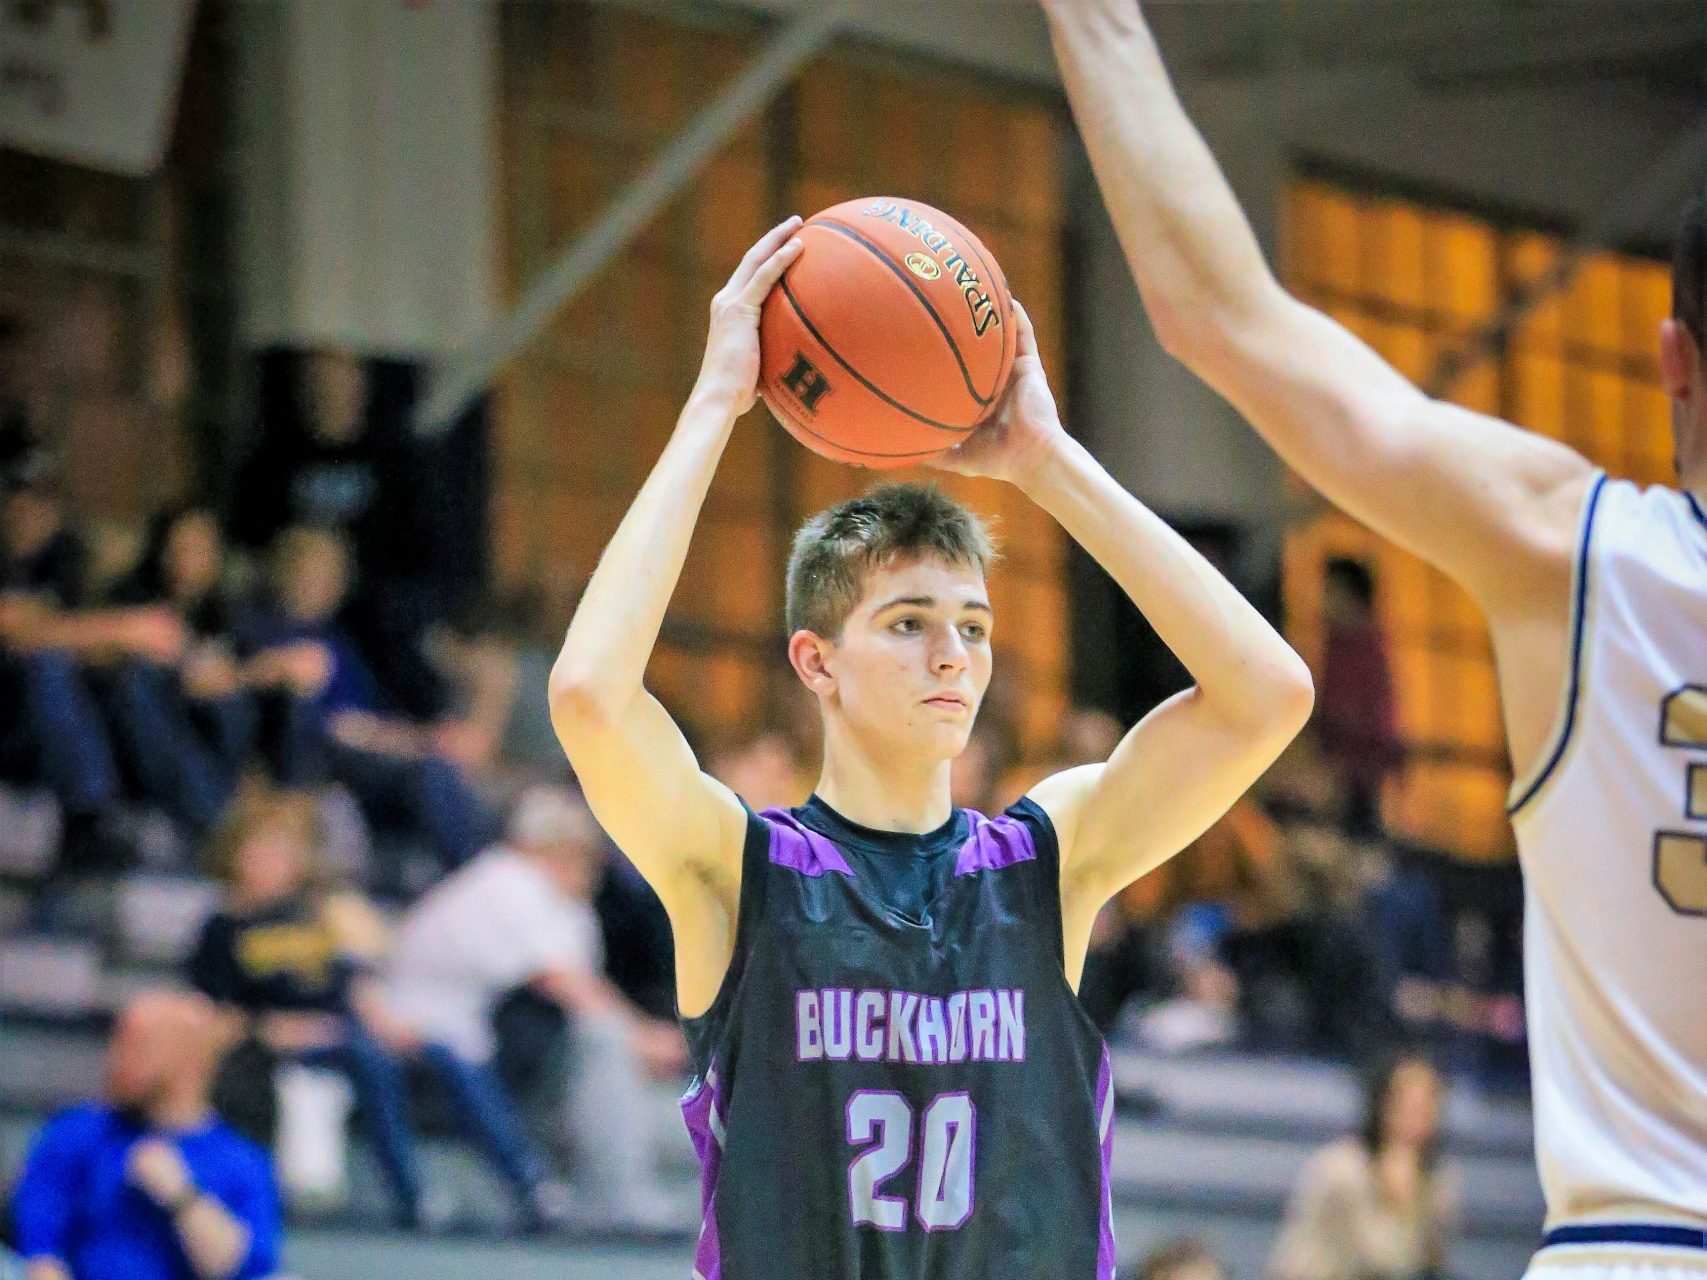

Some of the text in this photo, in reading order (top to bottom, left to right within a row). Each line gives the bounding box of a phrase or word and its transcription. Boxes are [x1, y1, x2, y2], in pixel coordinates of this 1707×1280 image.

[862, 198, 1000, 338] SPALDING
[796, 988, 1026, 1065] BUCKHORN
[844, 1088, 978, 1233] 20
